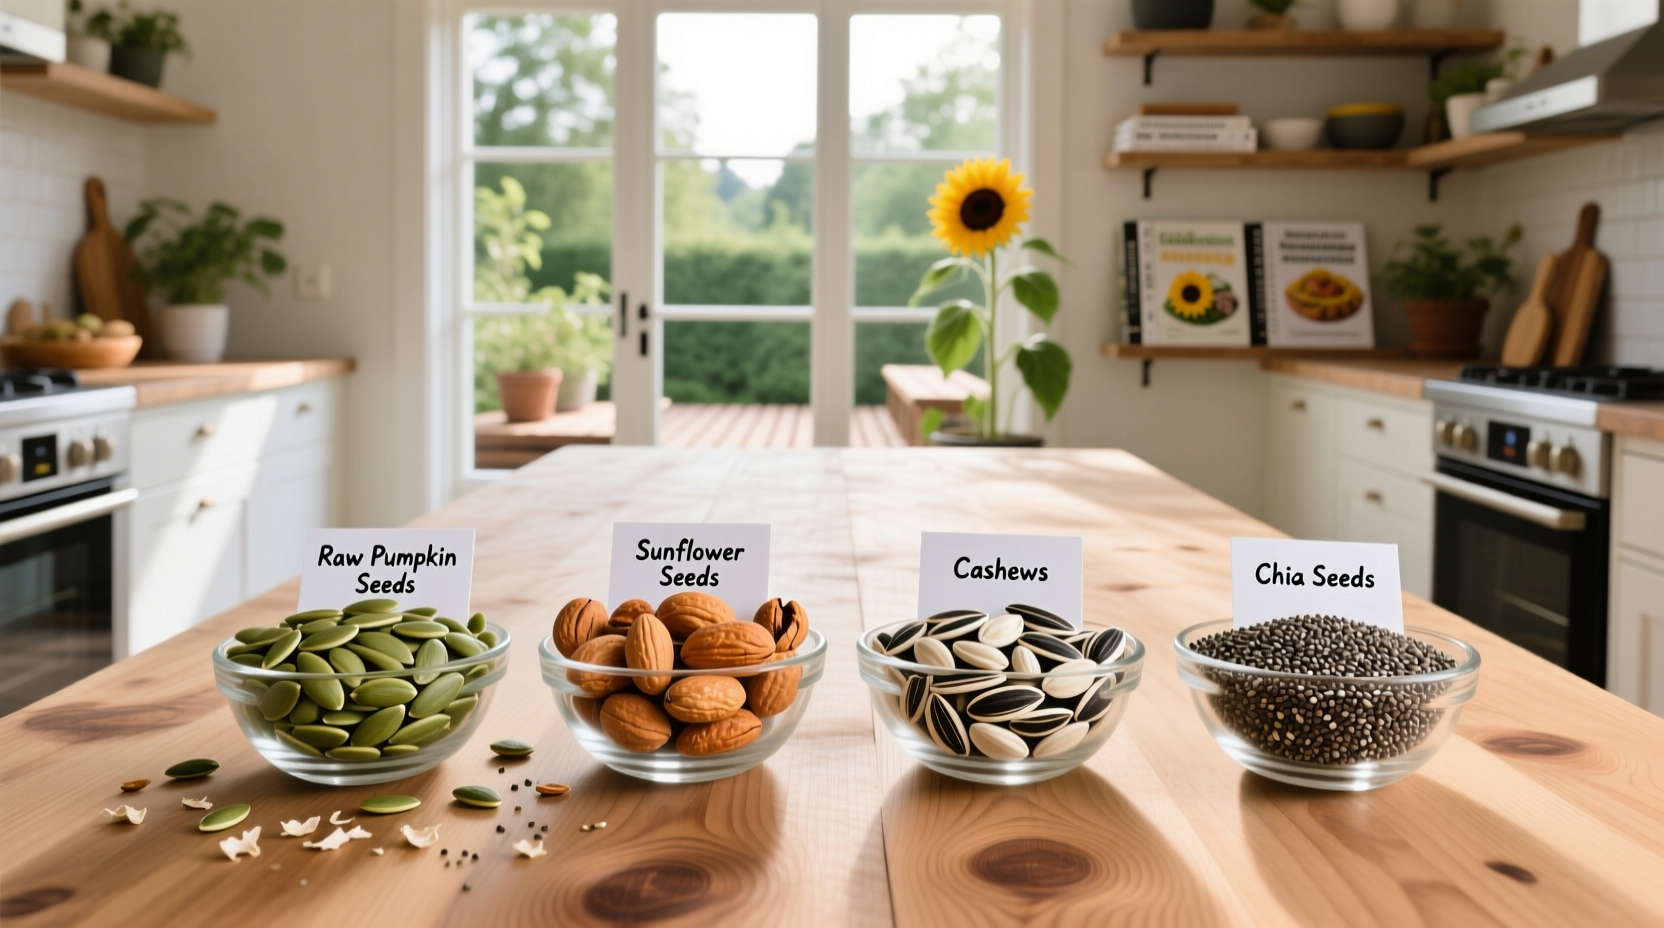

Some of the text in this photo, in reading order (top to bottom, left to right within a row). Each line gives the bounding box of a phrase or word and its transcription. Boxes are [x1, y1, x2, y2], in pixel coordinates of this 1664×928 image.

[317, 543, 457, 573] Raw Pumpkin
[635, 537, 745, 563] Sunflower
[659, 564, 719, 587] Seeds
[953, 556, 1049, 582] Cashews
[1255, 561, 1375, 589] Chia Seeds
[354, 571, 416, 594] Seeds
